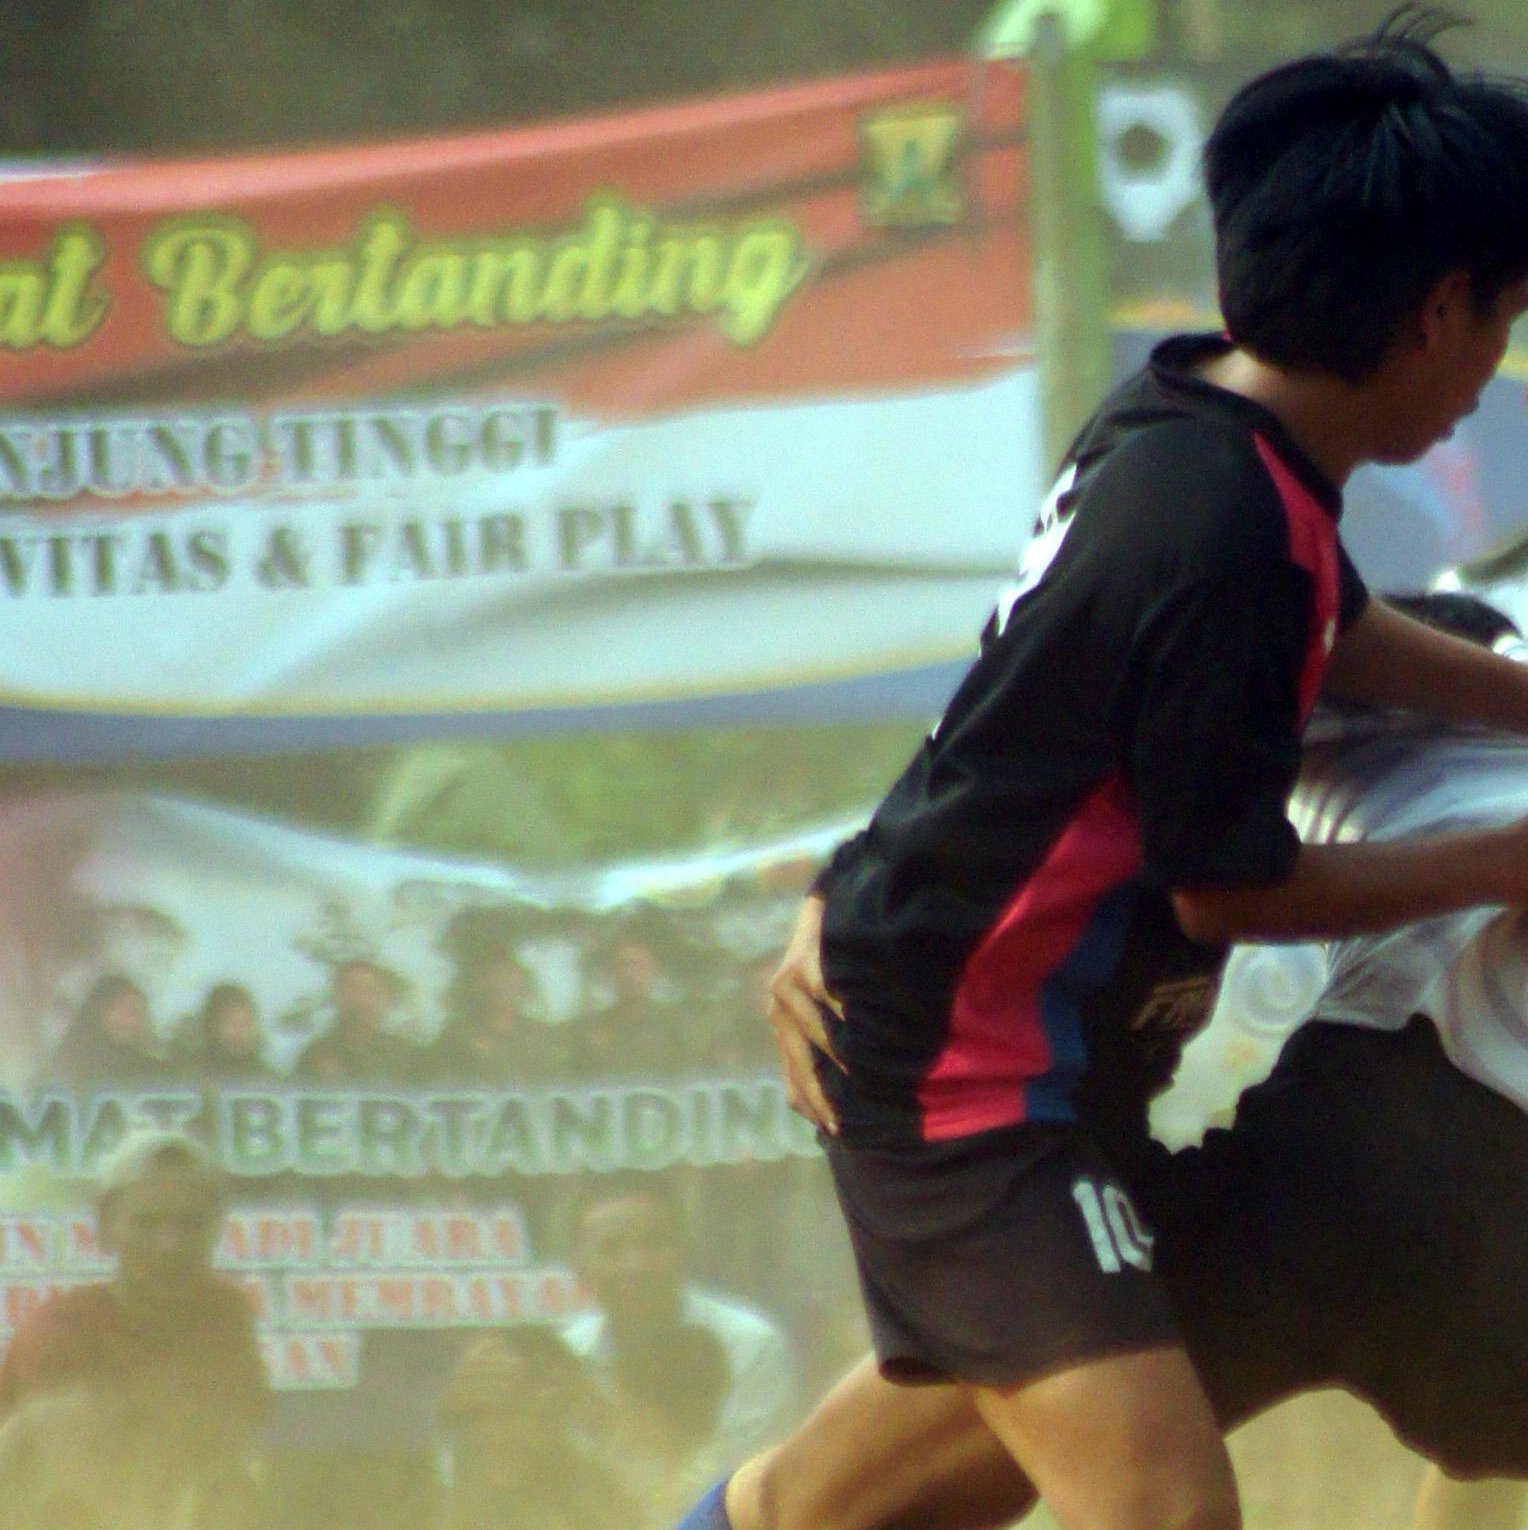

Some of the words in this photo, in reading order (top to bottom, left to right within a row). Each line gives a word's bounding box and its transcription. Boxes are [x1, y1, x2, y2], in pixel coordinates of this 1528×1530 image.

[150, 199, 808, 344] Bertanding
[276, 406, 560, 481] TINGGI
[257, 524, 311, 590] &
[338, 509, 530, 587] FAIR
[556, 497, 758, 571] PLAY
[232, 1083, 815, 1169] BERTANDIN
